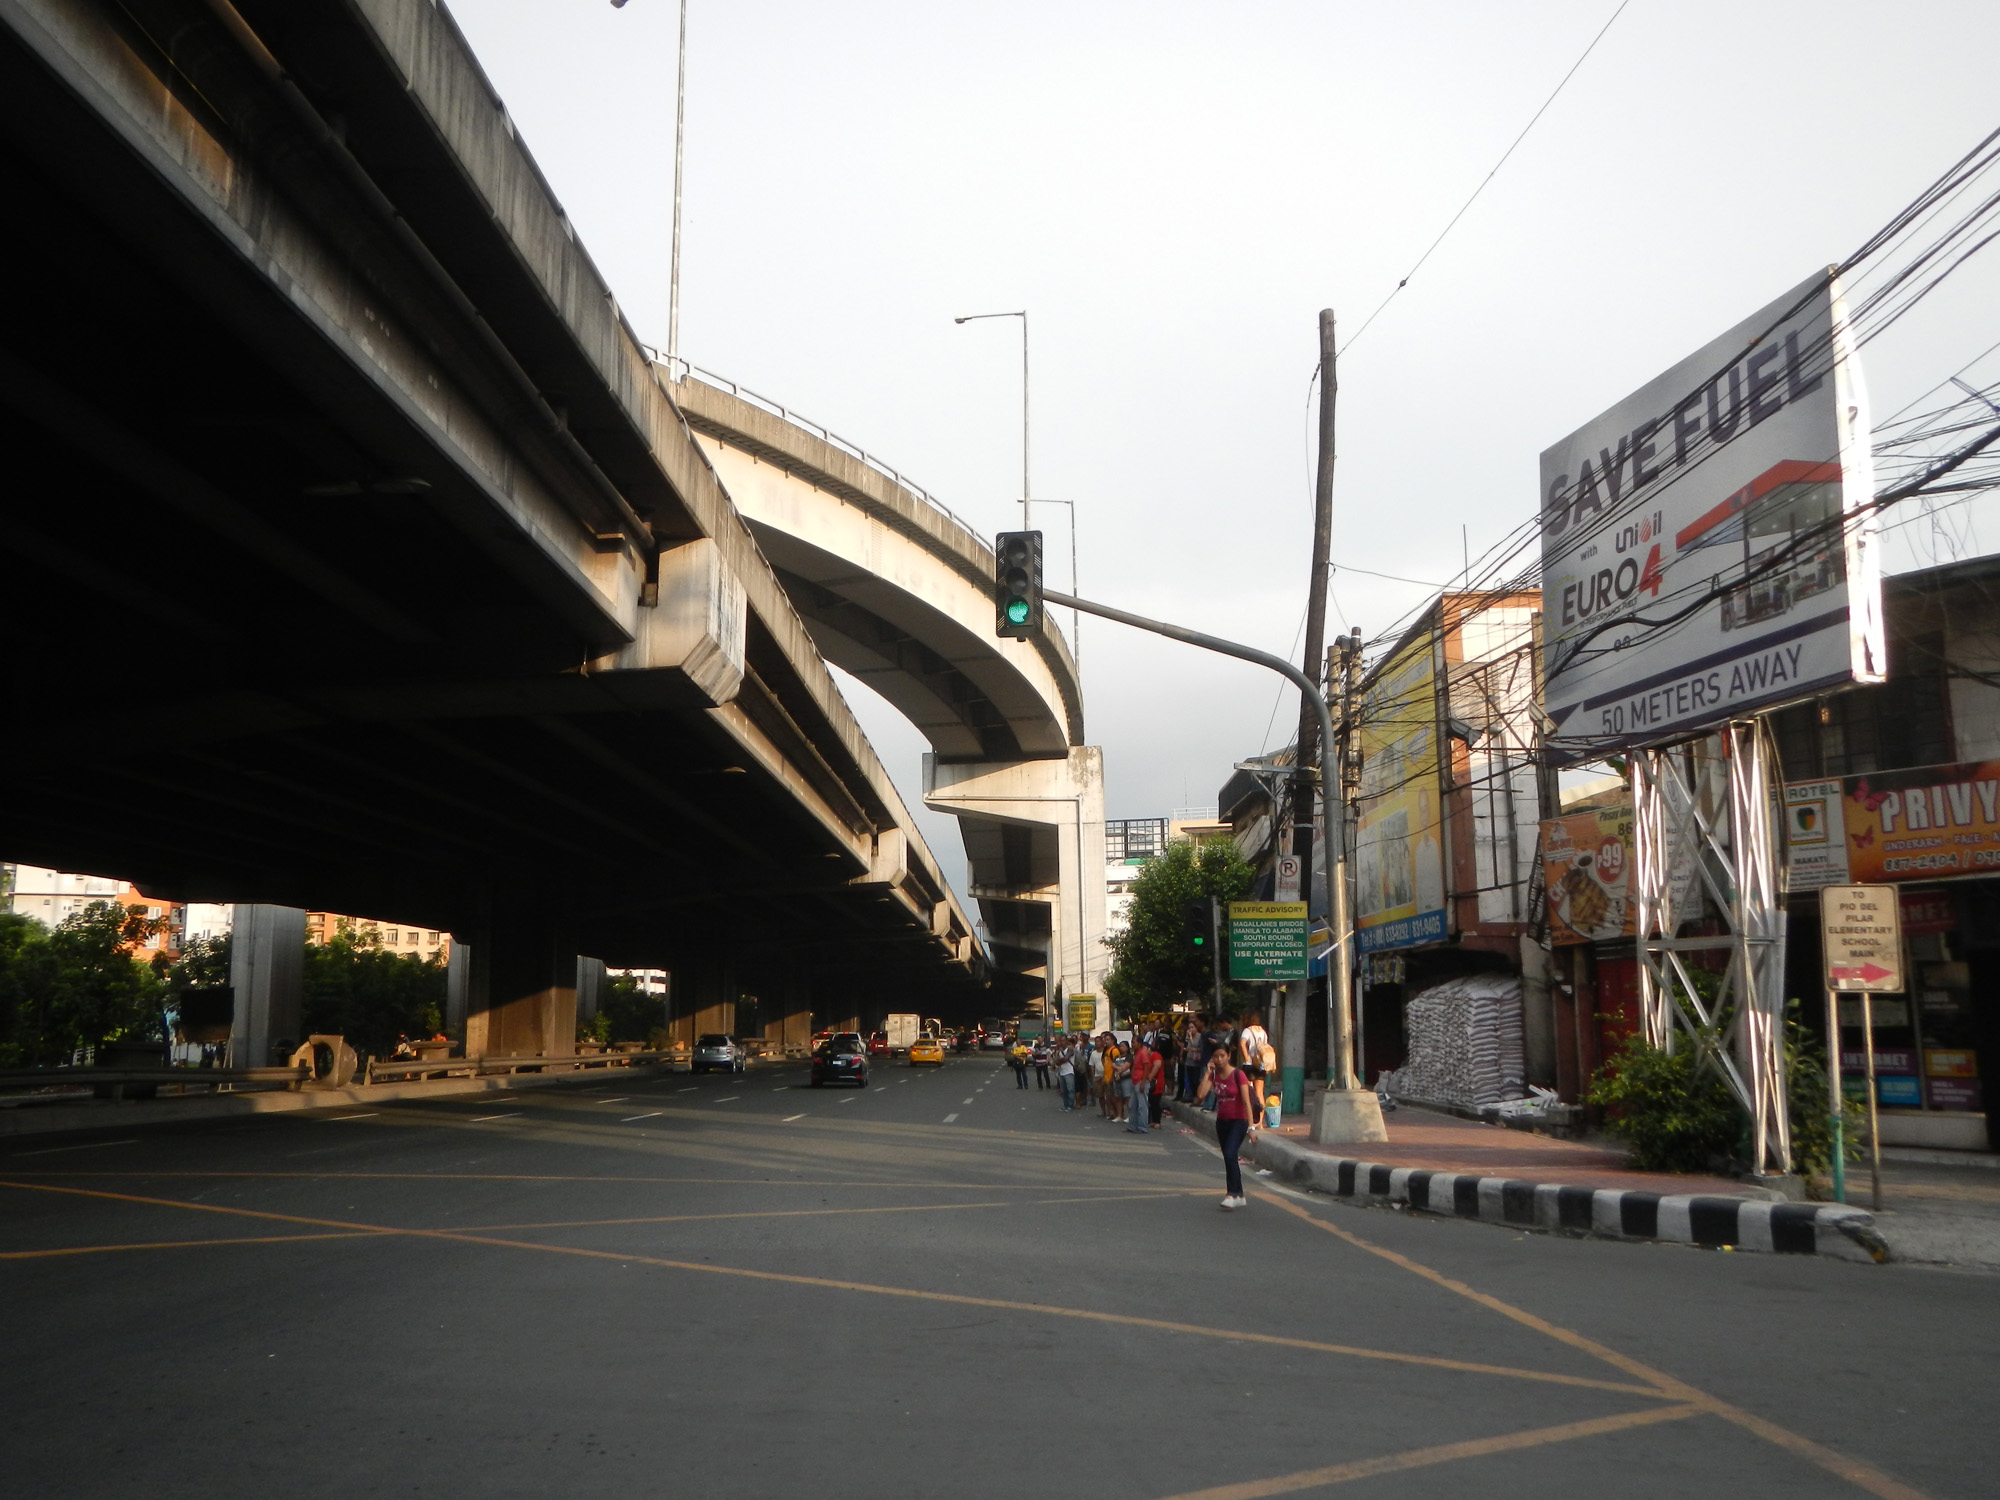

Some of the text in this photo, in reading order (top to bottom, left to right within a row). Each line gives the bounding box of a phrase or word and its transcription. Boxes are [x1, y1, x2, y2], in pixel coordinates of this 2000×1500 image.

[1547, 329, 1823, 536] SAVE FUEL
[1580, 544, 1598, 562] with
[1602, 643, 1802, 735] 50 METERS AWAY
[1880, 780, 1998, 833] PRIVY
[1884, 837, 1943, 851] UNDERARM
[1953, 834, 1981, 845] FACE
[1794, 855, 1827, 865] MAKATI
[1851, 891, 1865, 899] TO
[1840, 903, 1878, 911] PIO DEL
[1828, 926, 1893, 934] ELEMENTARY
[1841, 938, 1881, 946] SCHOOL
[1850, 950, 1875, 958] MAIN
[1842, 1053, 1908, 1066] INTRNET
